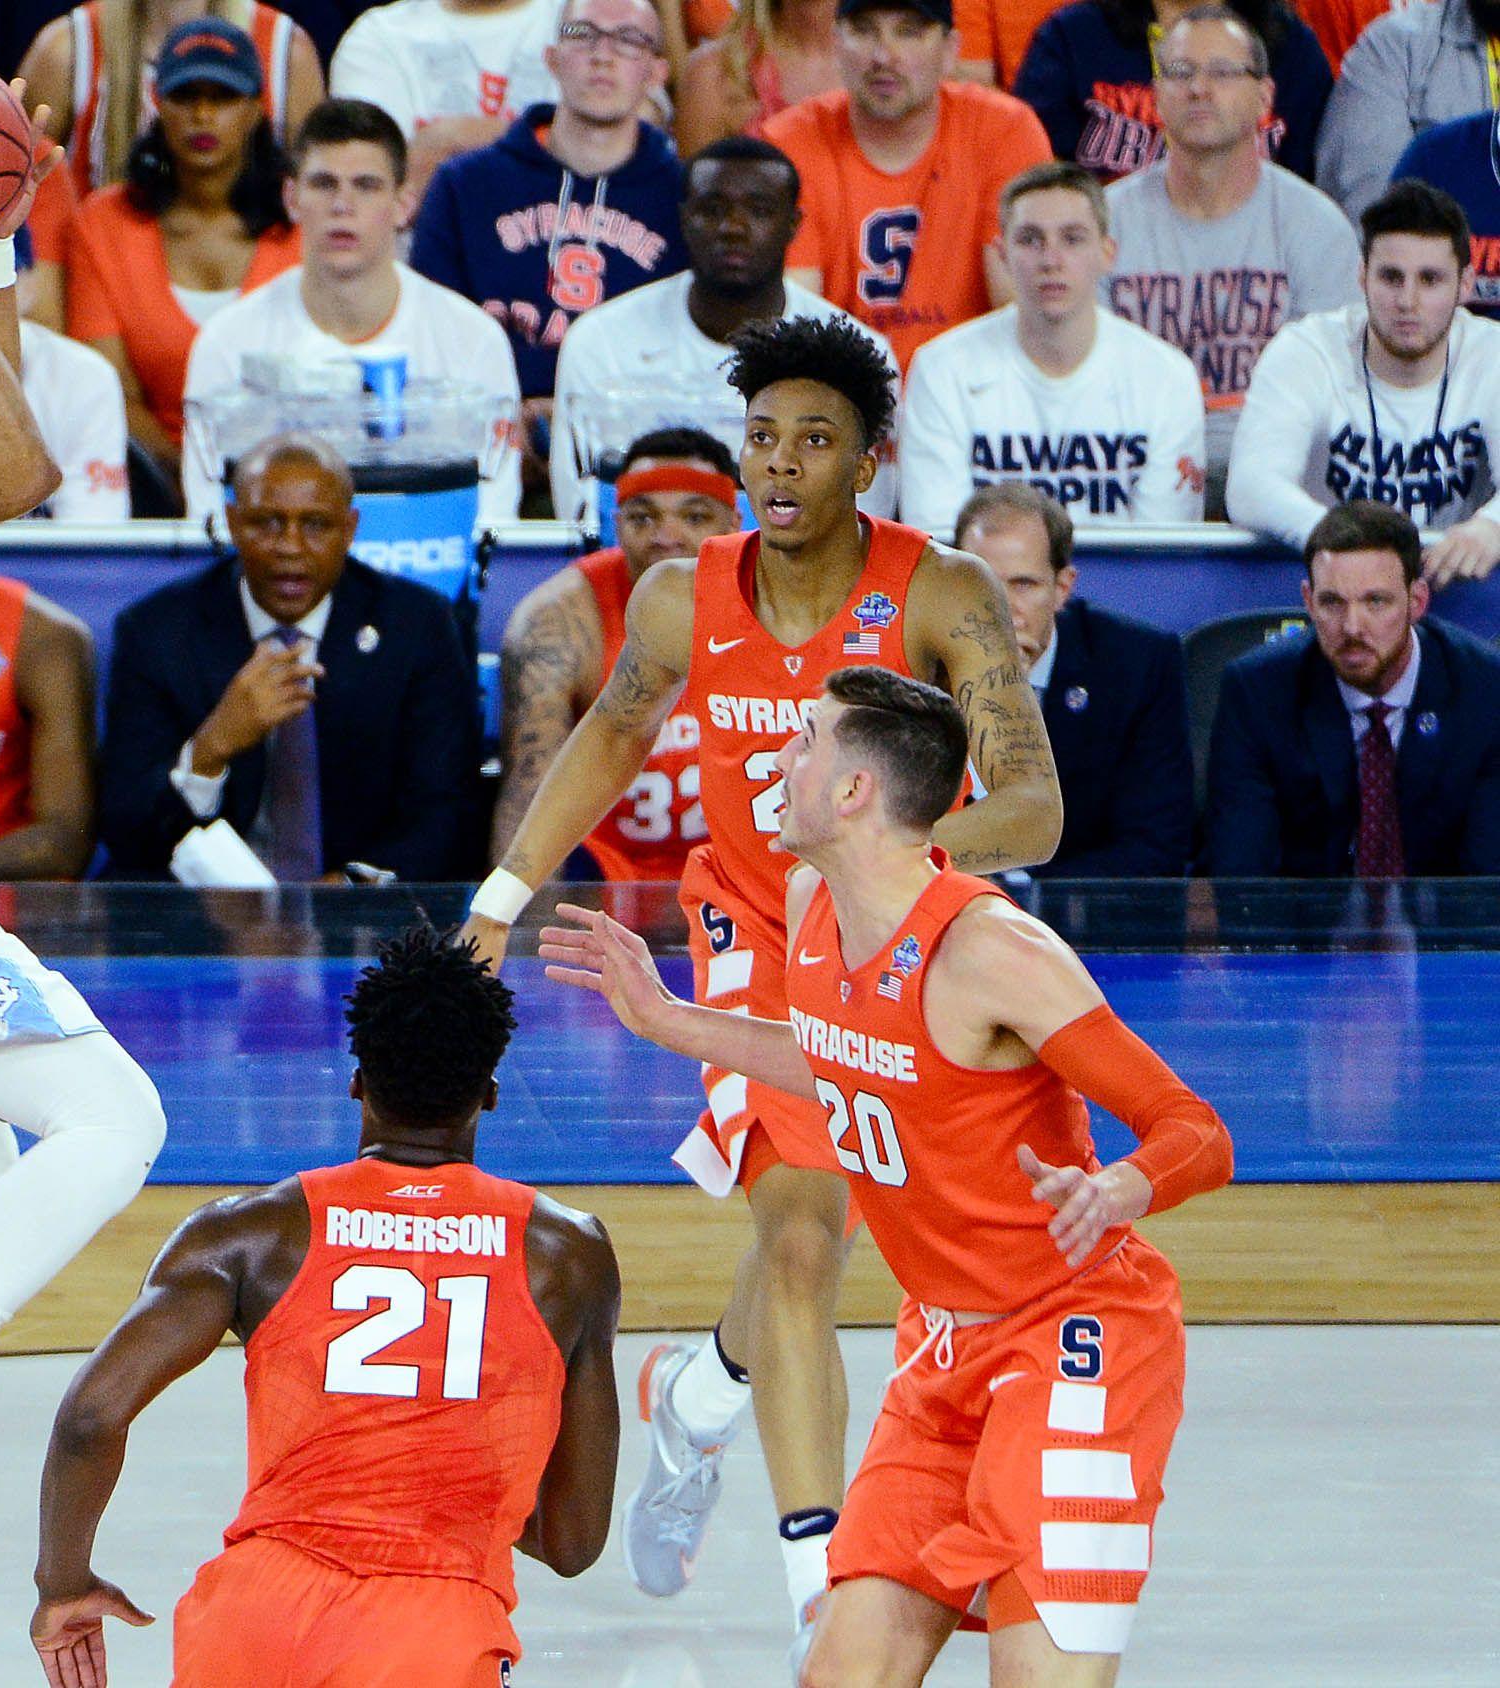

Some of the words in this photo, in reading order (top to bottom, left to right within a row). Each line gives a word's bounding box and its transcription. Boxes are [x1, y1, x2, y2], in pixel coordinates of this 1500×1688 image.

[496, 202, 668, 272] SYRACUSE
[858, 205, 922, 307] S
[551, 243, 606, 312] S
[1108, 269, 1289, 356] SYRACUSE
[972, 433, 1147, 472] ALWAYS
[789, 1005, 919, 1083] SYRACUSE
[814, 1075, 909, 1188] 20
[386, 1184, 445, 1198] ACC
[325, 1205, 507, 1257] ROBERSON
[323, 1263, 490, 1400] 21
[1058, 1314, 1104, 1382] S
